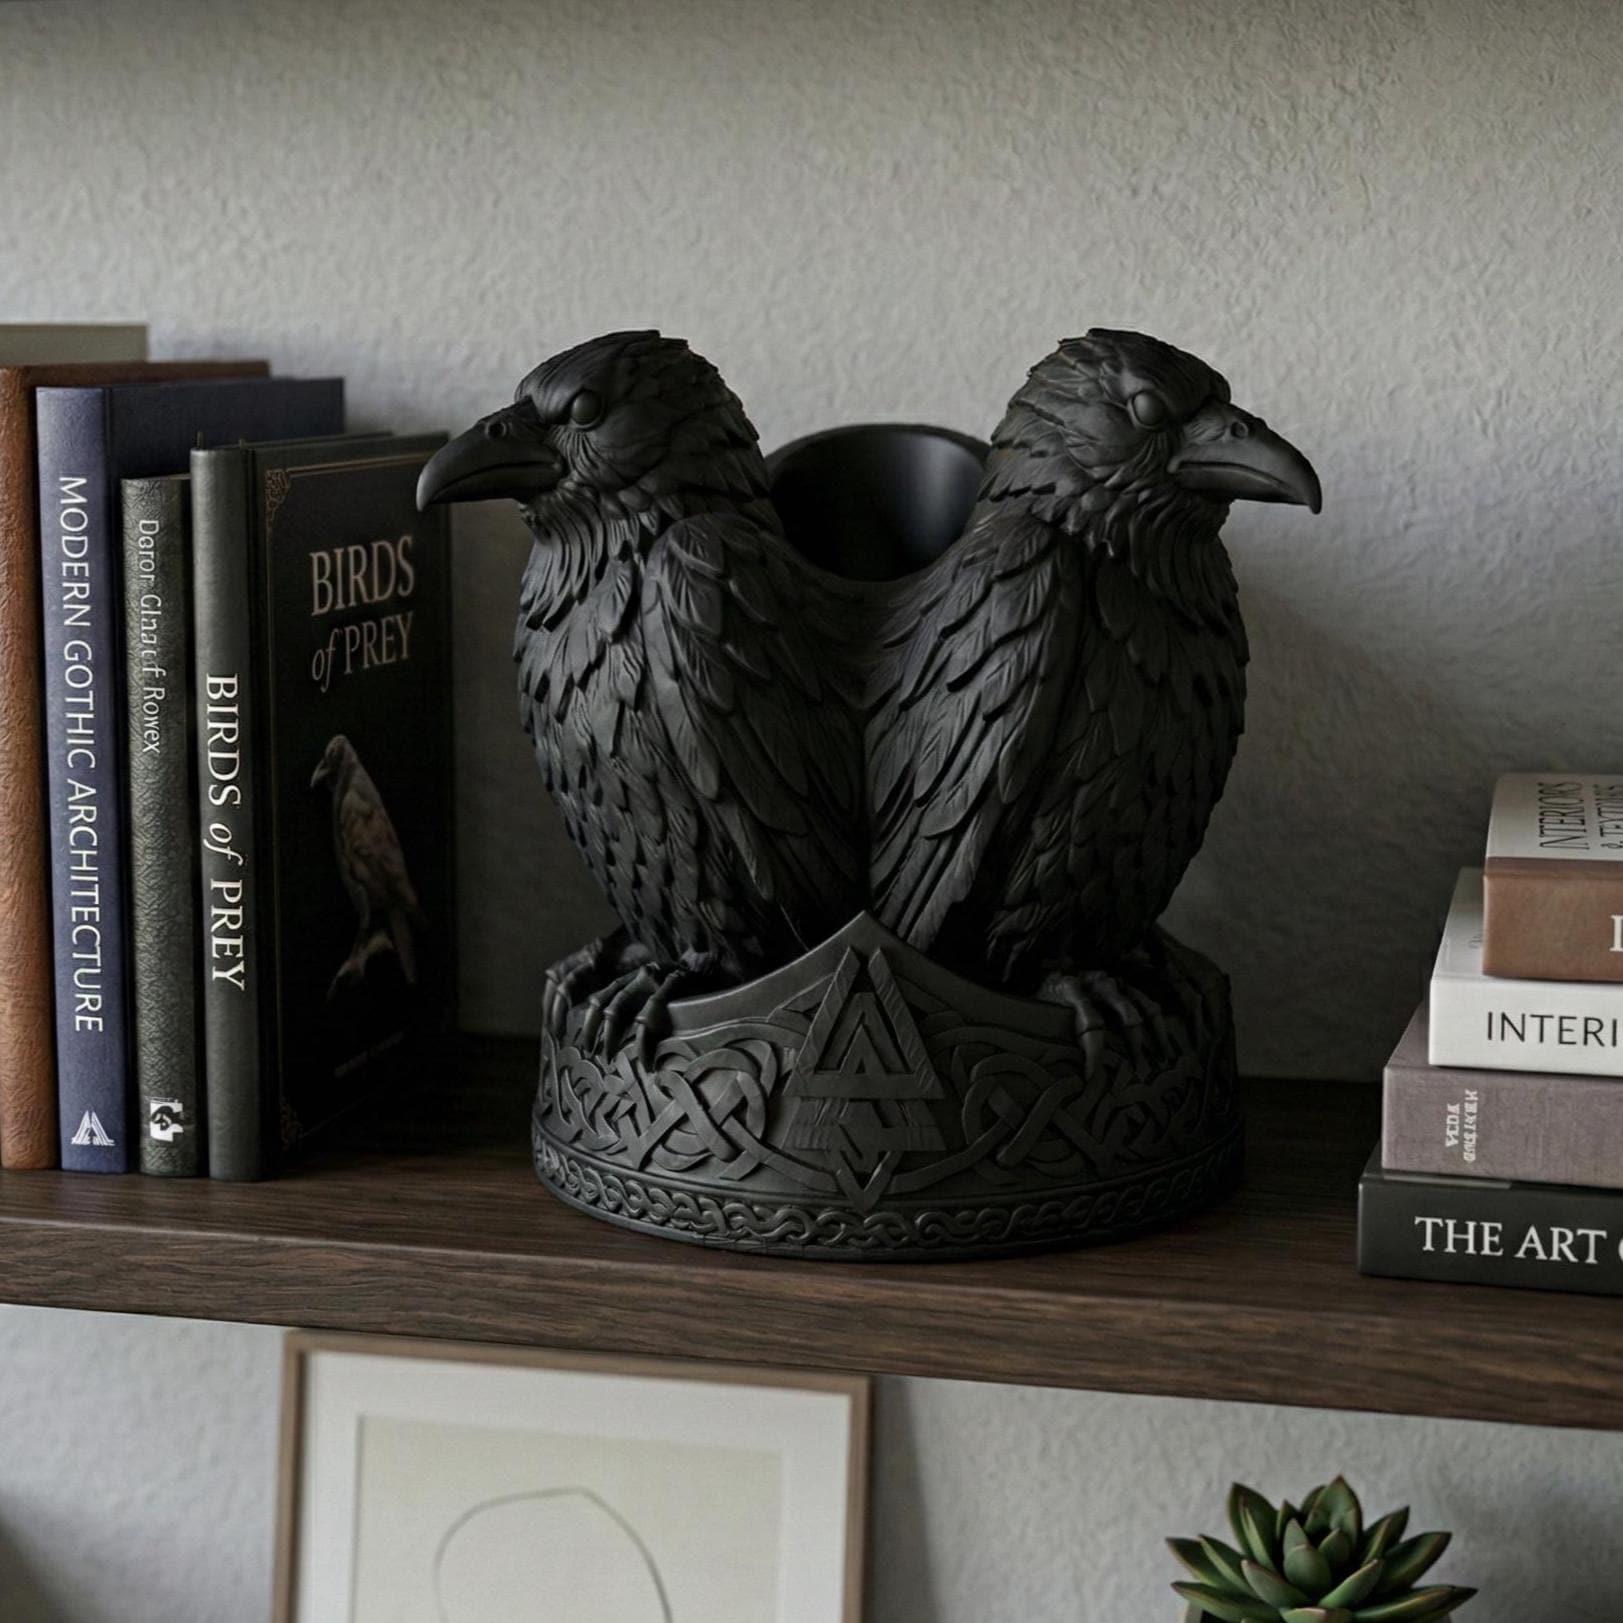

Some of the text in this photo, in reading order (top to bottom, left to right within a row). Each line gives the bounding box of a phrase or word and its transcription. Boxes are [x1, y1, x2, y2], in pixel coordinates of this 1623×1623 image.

[309, 534, 416, 616] BIRDS
[311, 611, 414, 693] of PREY
[59, 476, 103, 1032] MODERN GOTHIC ARCHITECTURE
[142, 686, 166, 754] Rowex
[203, 672, 245, 991] BIRDS of PREY
[1487, 1011, 1618, 1048] INTERI
[1414, 1216, 1504, 1256] THE
[1513, 1225, 1608, 1264] ART
